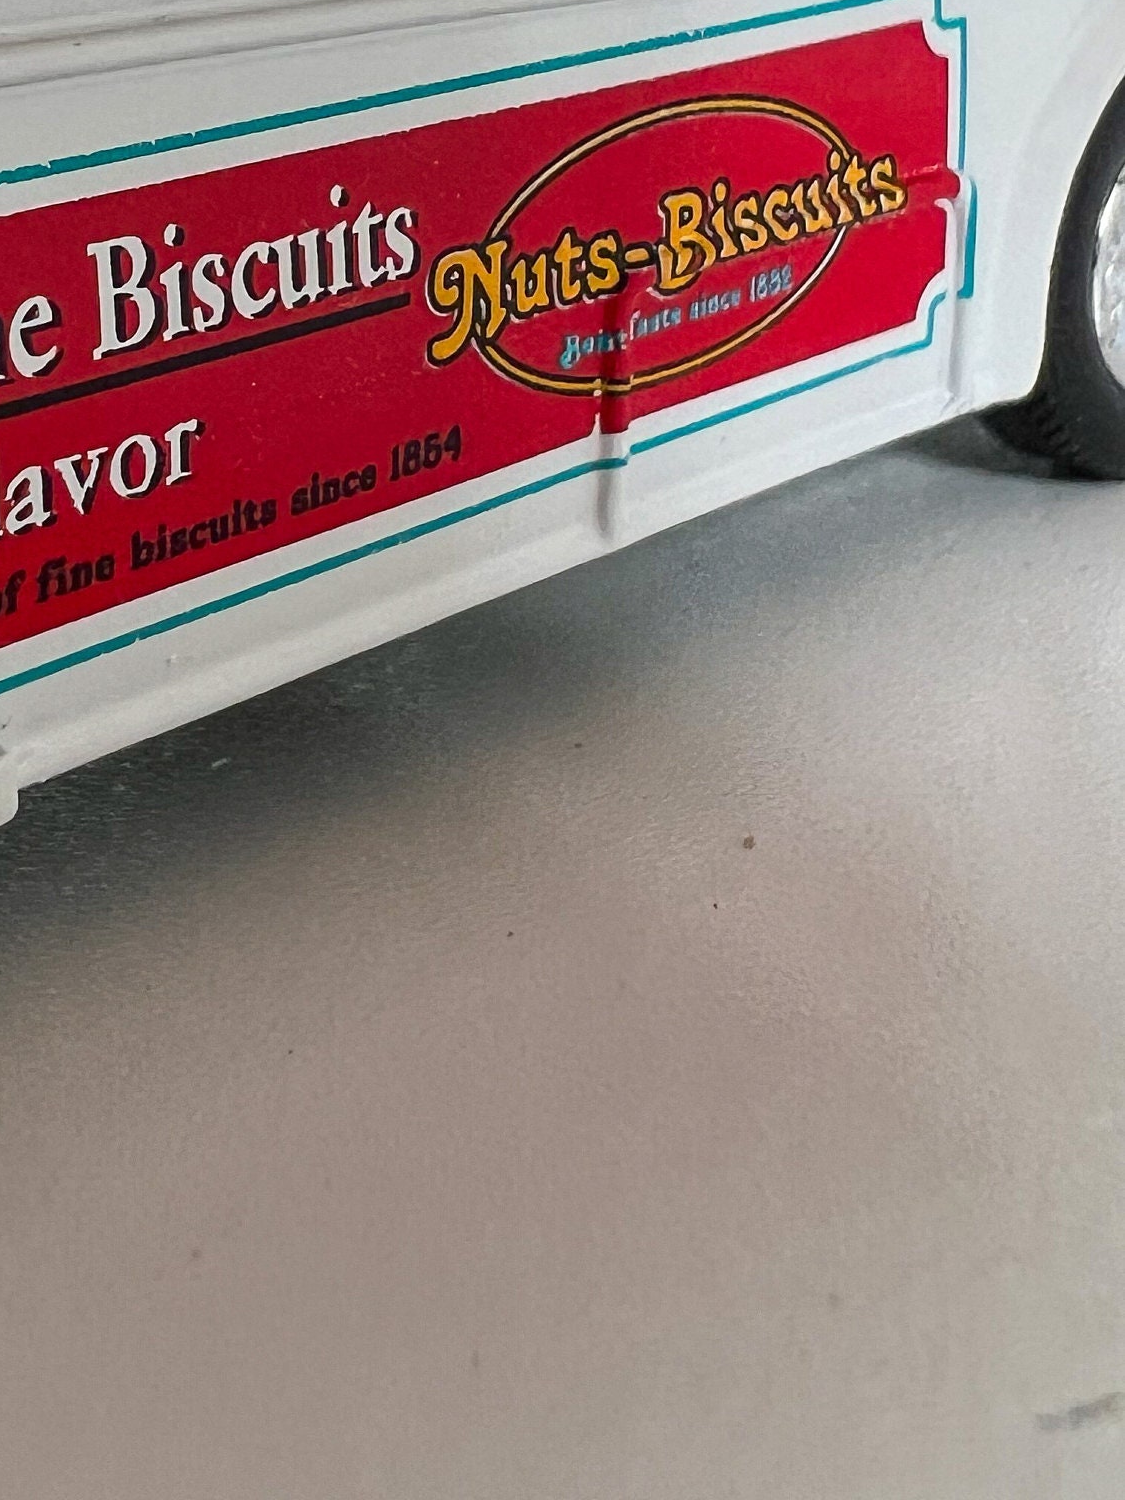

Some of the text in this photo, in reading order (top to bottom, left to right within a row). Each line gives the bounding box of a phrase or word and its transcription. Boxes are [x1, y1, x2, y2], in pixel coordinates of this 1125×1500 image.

[86, 183, 420, 361] Biscuits
[427, 152, 908, 367] Nuts-Biscuits
[35, 554, 117, 604] fine
[130, 498, 278, 570] biscuits
[290, 471, 377, 517] since
